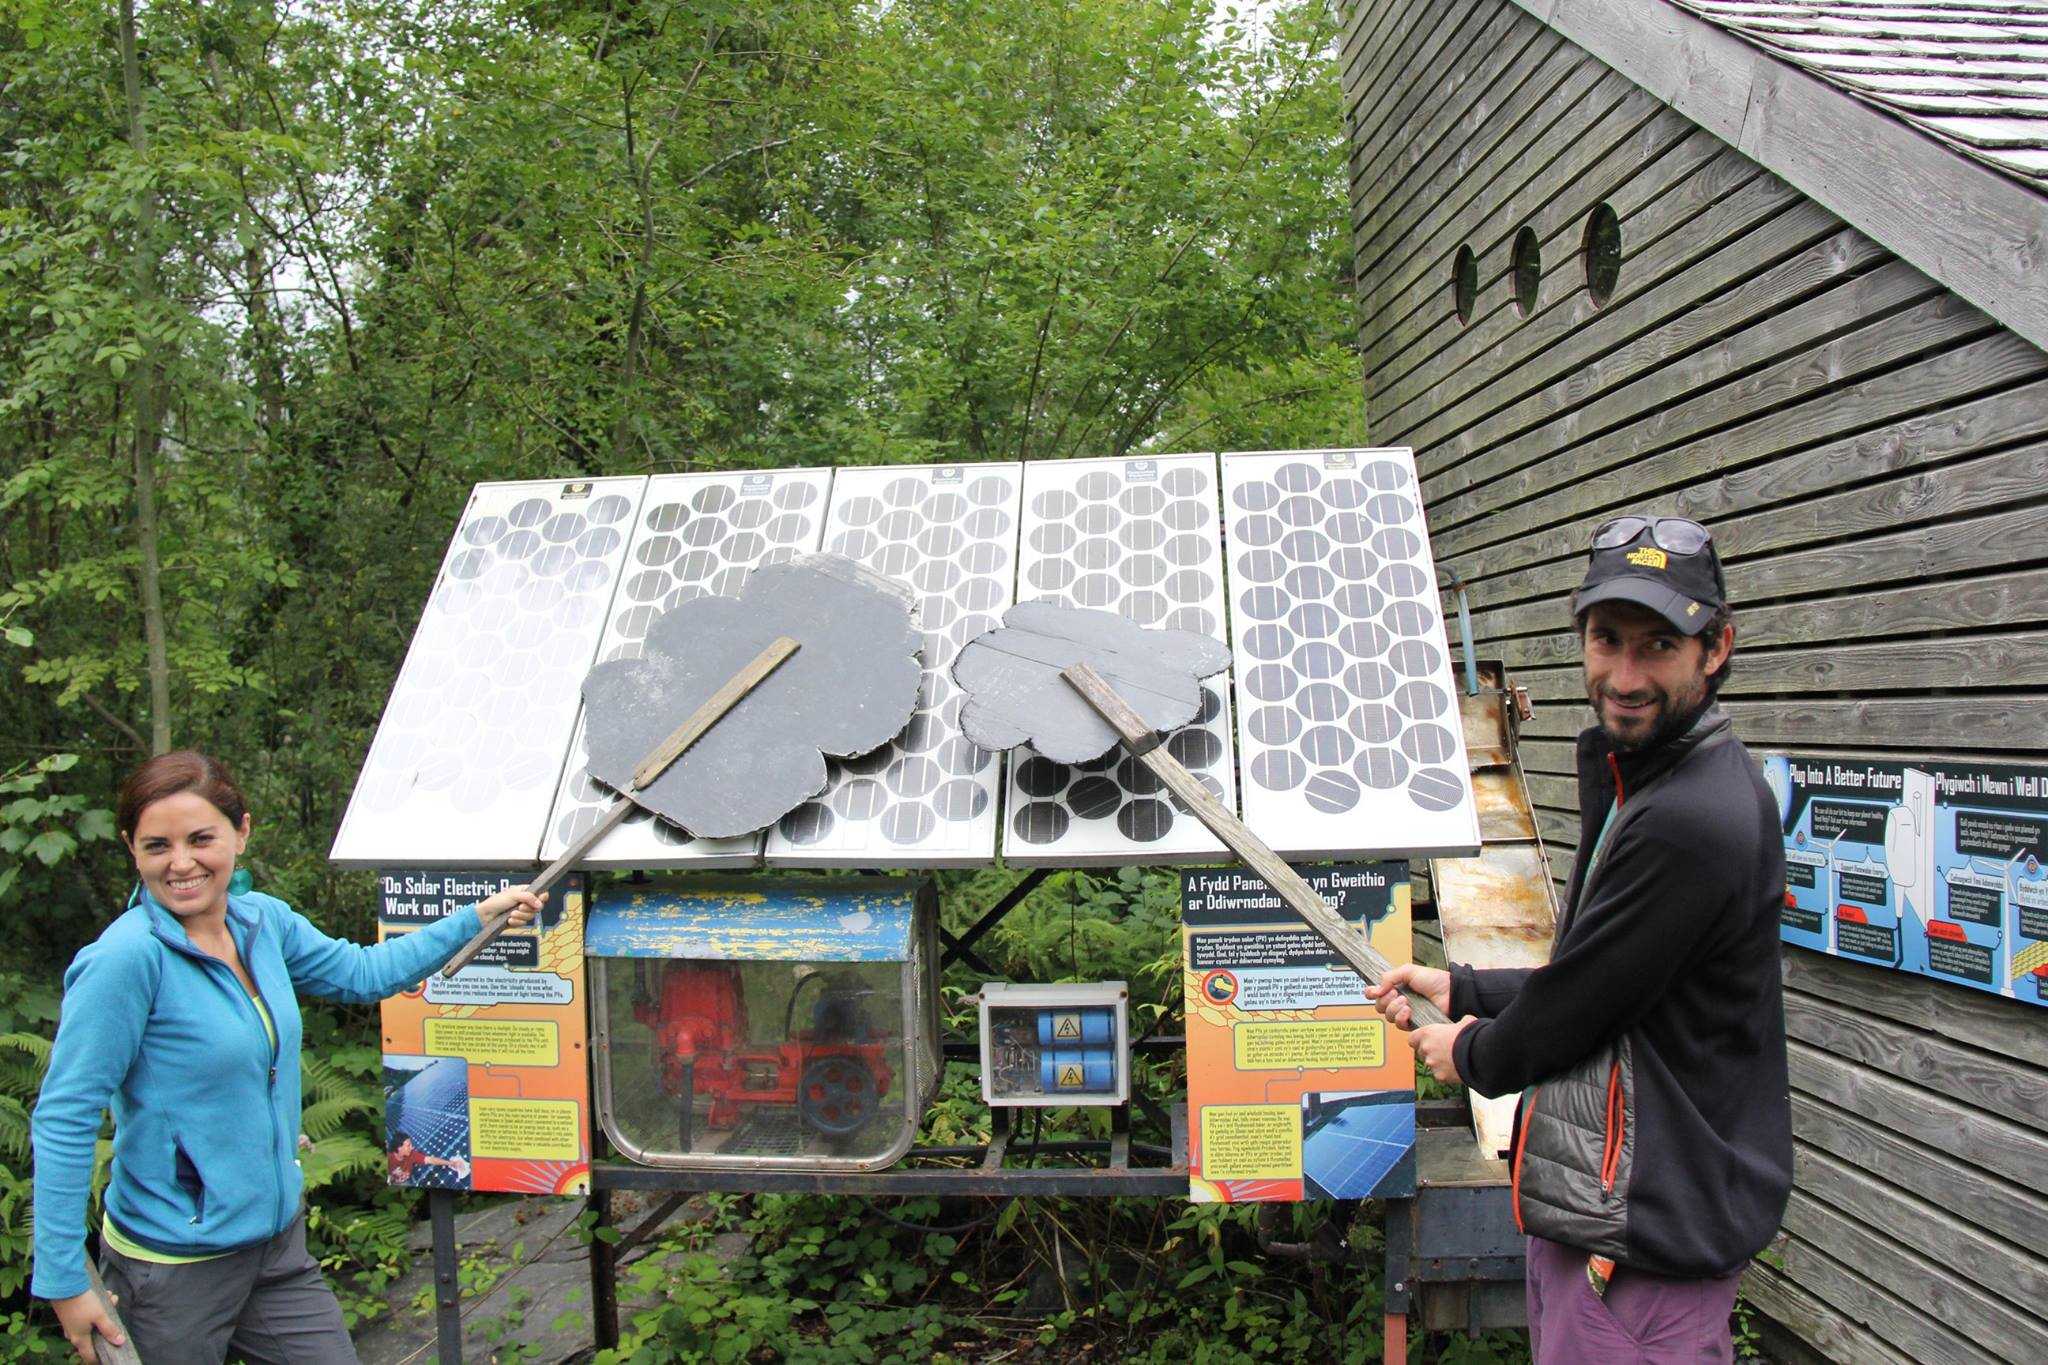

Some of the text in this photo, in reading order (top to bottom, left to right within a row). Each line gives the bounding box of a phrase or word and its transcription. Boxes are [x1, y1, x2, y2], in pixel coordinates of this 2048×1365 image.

[1627, 553, 1656, 561] NORTH
[1639, 547, 1656, 556] THE
[1631, 559, 1657, 568] FACE
[1790, 764, 1901, 789] Plug Into A Better Future
[1936, 772, 1975, 795] Plygiwch
[1977, 776, 1980, 793] i
[1982, 774, 2007, 795] Mewn
[2010, 778, 2013, 795] i
[2016, 776, 2038, 797] Well
[386, 877, 401, 894] Do
[406, 877, 440, 895] Solar
[445, 878, 496, 896] Electric
[1188, 876, 1196, 892] A
[1200, 876, 1229, 894] Fydd
[1313, 878, 1327, 891] yn
[1332, 872, 1385, 888] Gweithio
[385, 897, 419, 915] Work
[423, 904, 438, 915] on
[1189, 899, 1203, 910] ar
[1207, 893, 1281, 910] Ddiwrnodau
